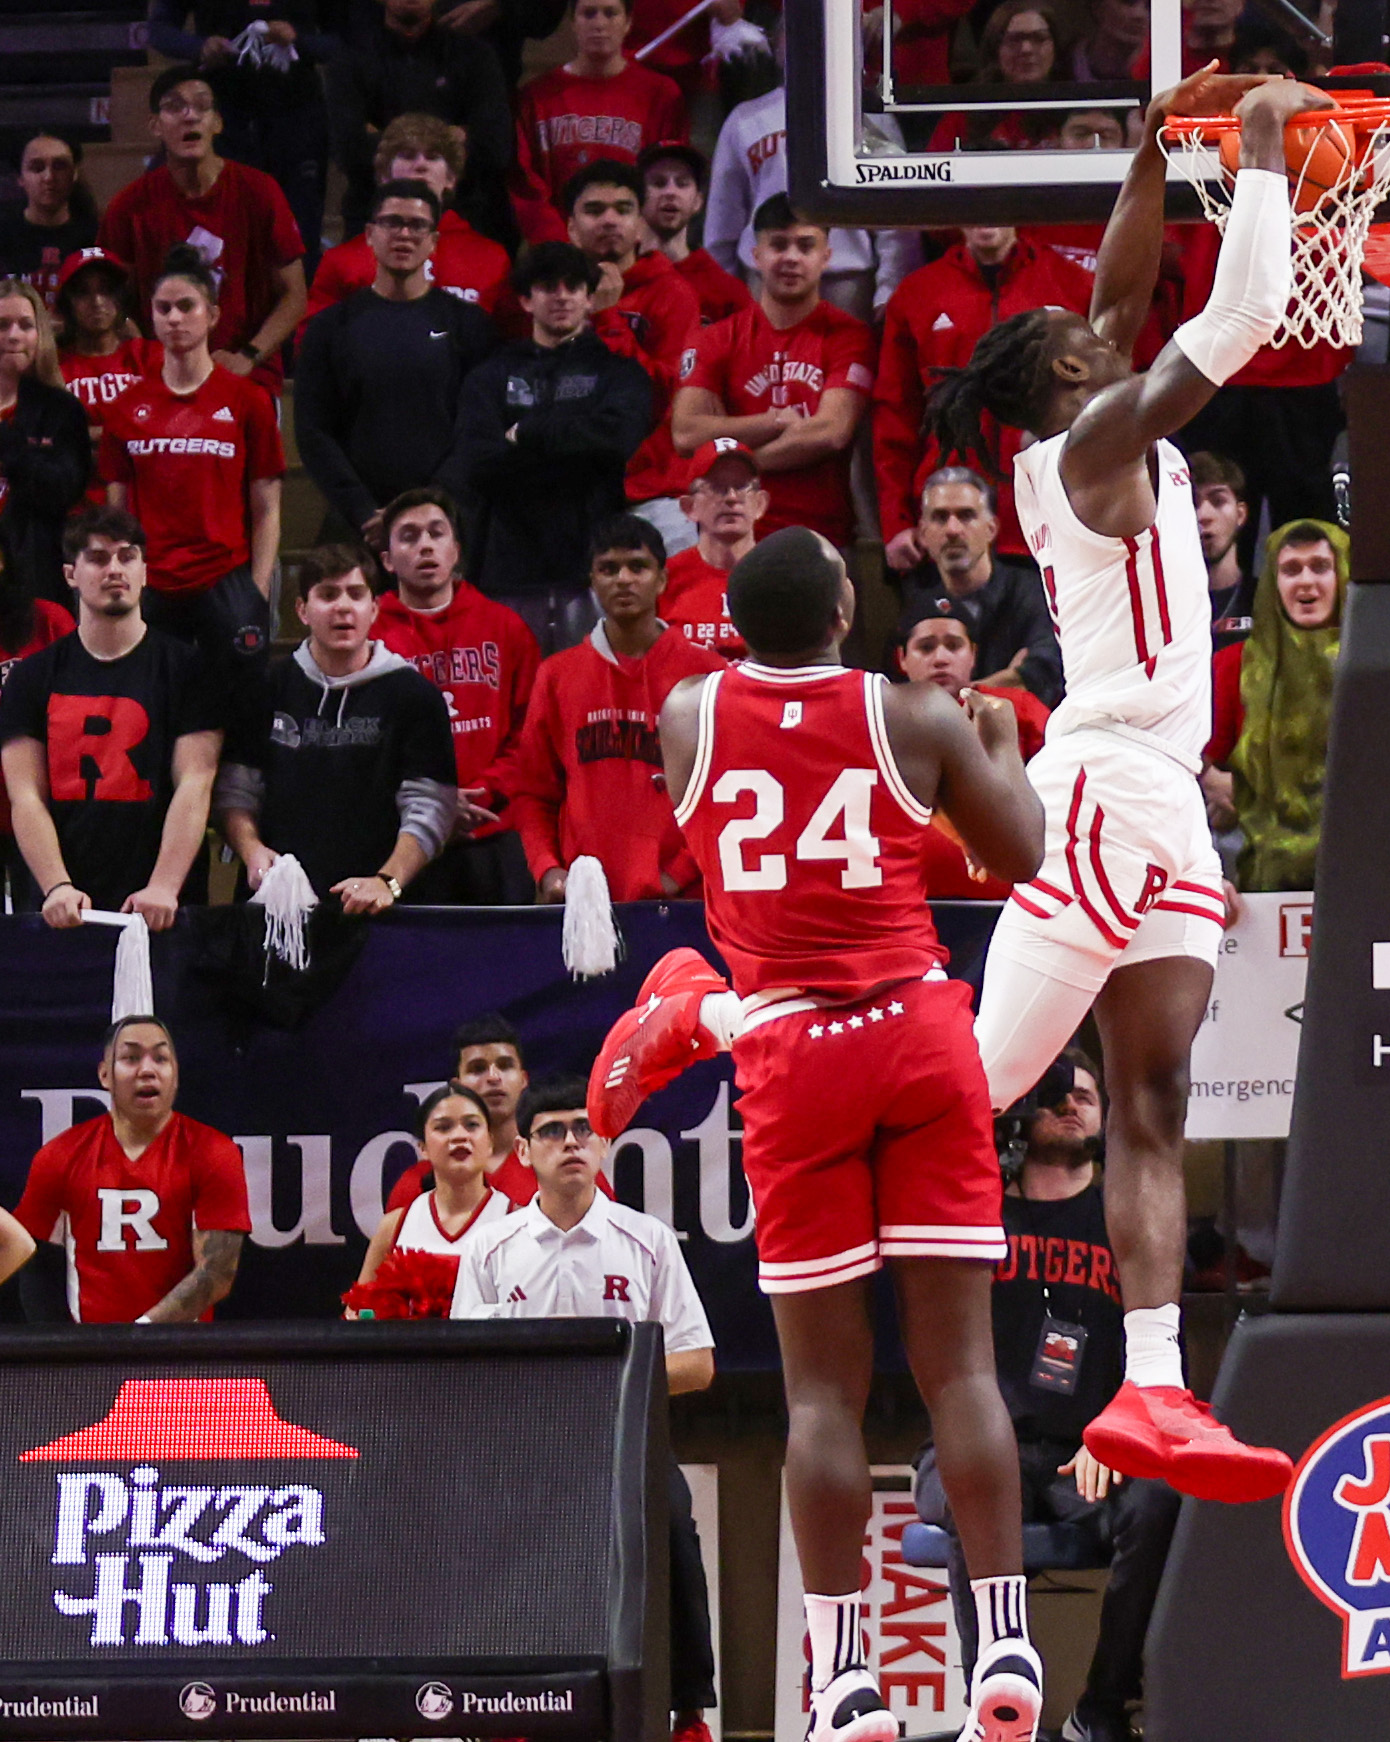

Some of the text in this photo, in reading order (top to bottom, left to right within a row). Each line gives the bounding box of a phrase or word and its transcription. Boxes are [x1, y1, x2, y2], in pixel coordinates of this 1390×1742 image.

[855, 161, 951, 185] SPALDING
[127, 437, 236, 458] RUTGERS
[697, 622, 715, 639] 22
[47, 692, 154, 802] R
[712, 767, 883, 892] 24
[97, 1187, 169, 1252] R
[603, 1273, 632, 1303] R
[50, 1464, 326, 1565] Pizza
[54, 1552, 277, 1648] Hut
[226, 1689, 337, 1713] Prudential
[461, 1689, 574, 1714] Prudential
